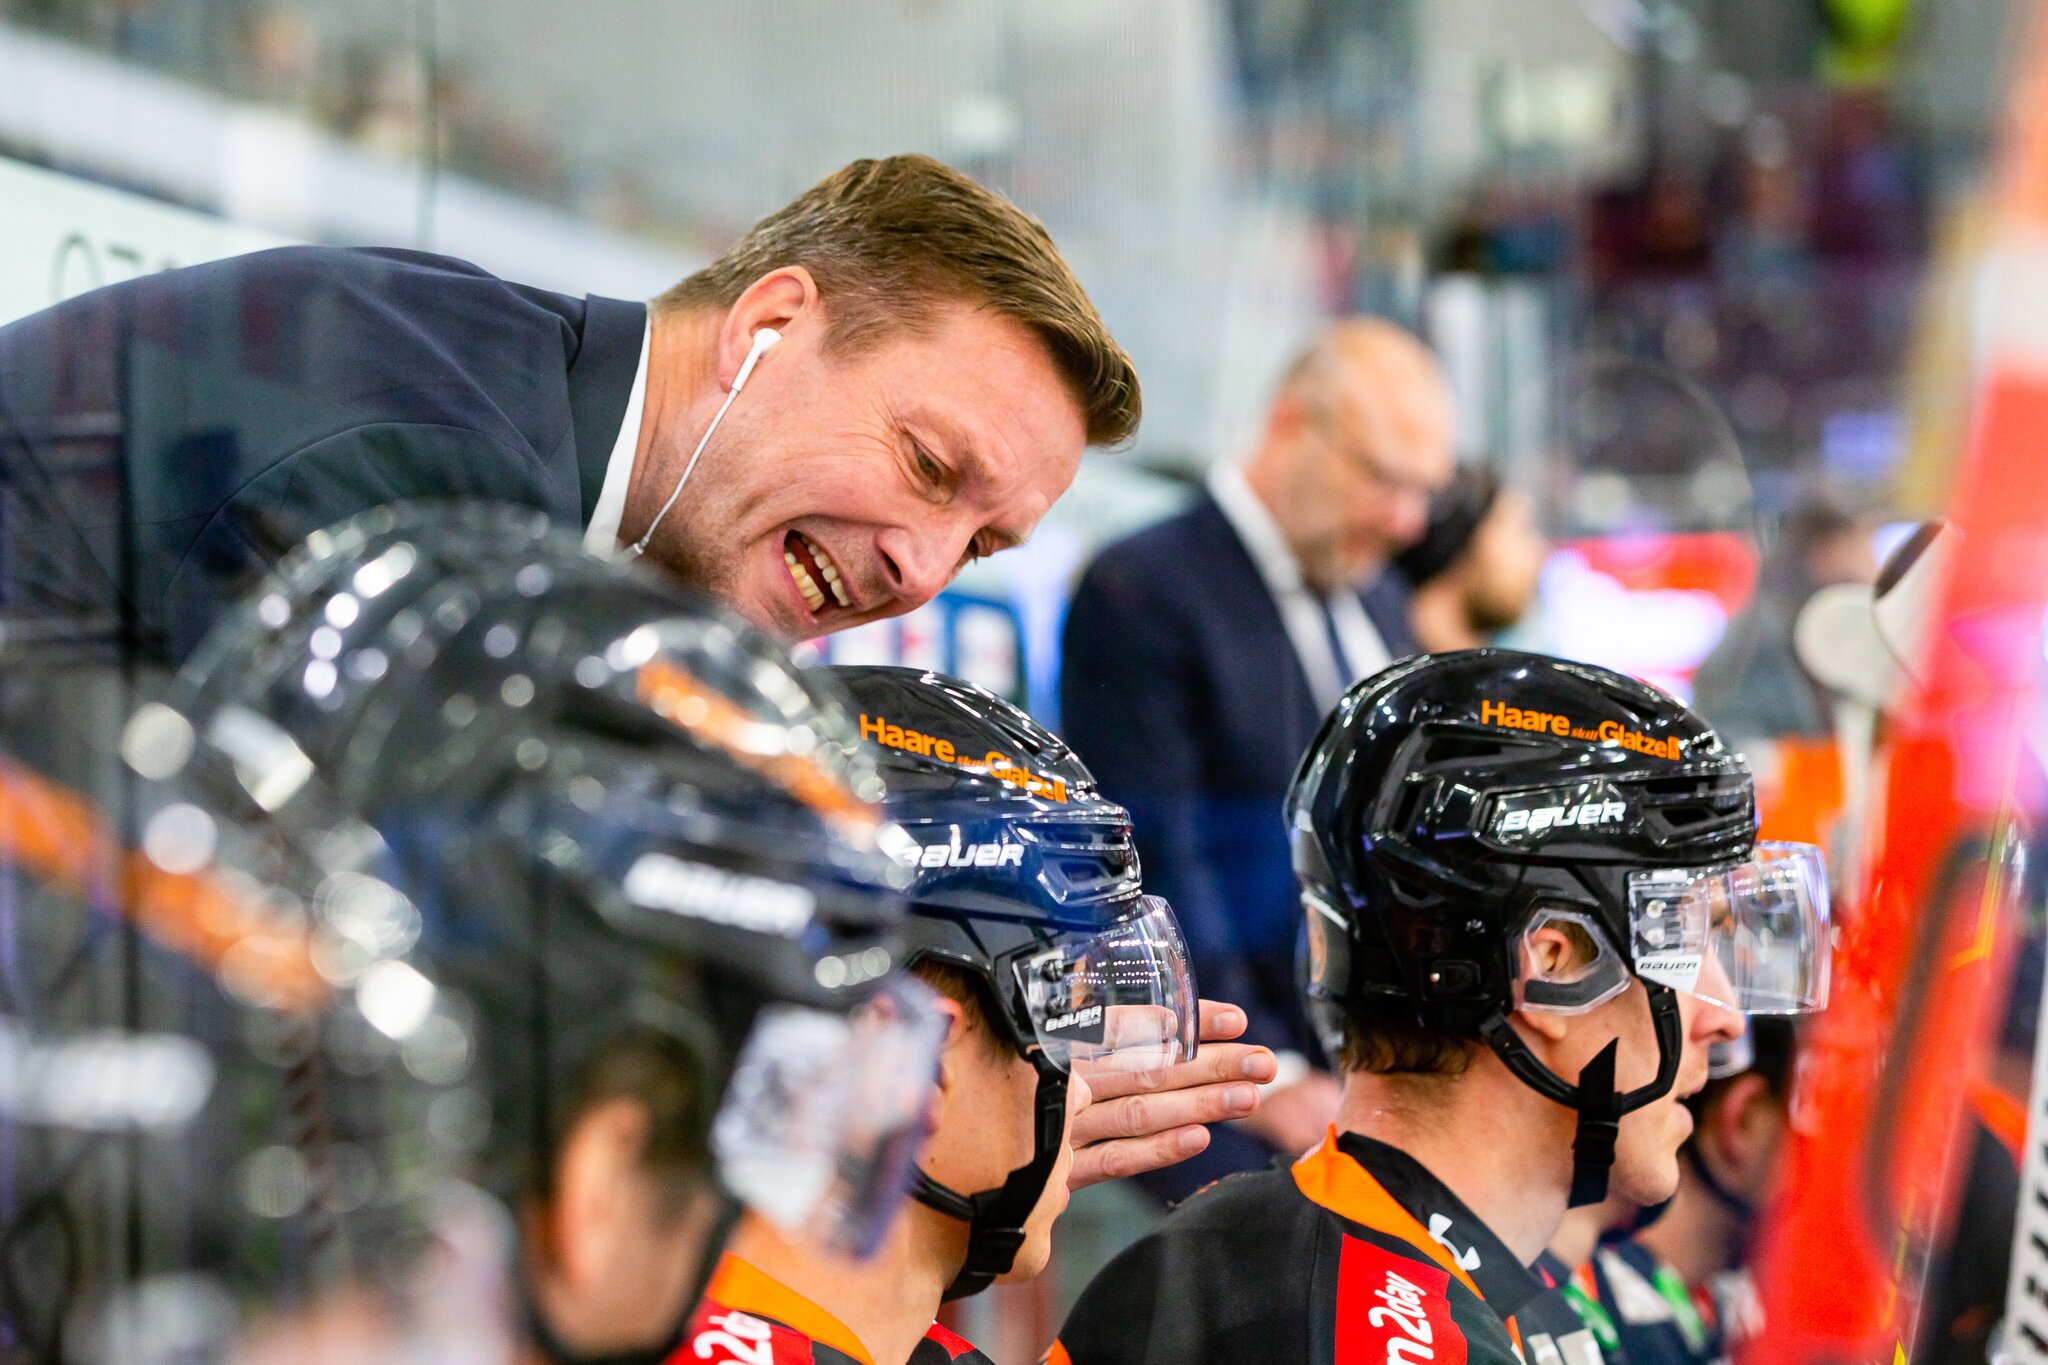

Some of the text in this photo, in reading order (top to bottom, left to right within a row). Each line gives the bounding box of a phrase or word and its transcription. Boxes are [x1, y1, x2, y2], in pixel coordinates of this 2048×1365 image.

[1481, 700, 1570, 737] Haare
[859, 713, 955, 763] Haare
[1502, 801, 1627, 832] BAUER
[1045, 1004, 1102, 1032] BAUER
